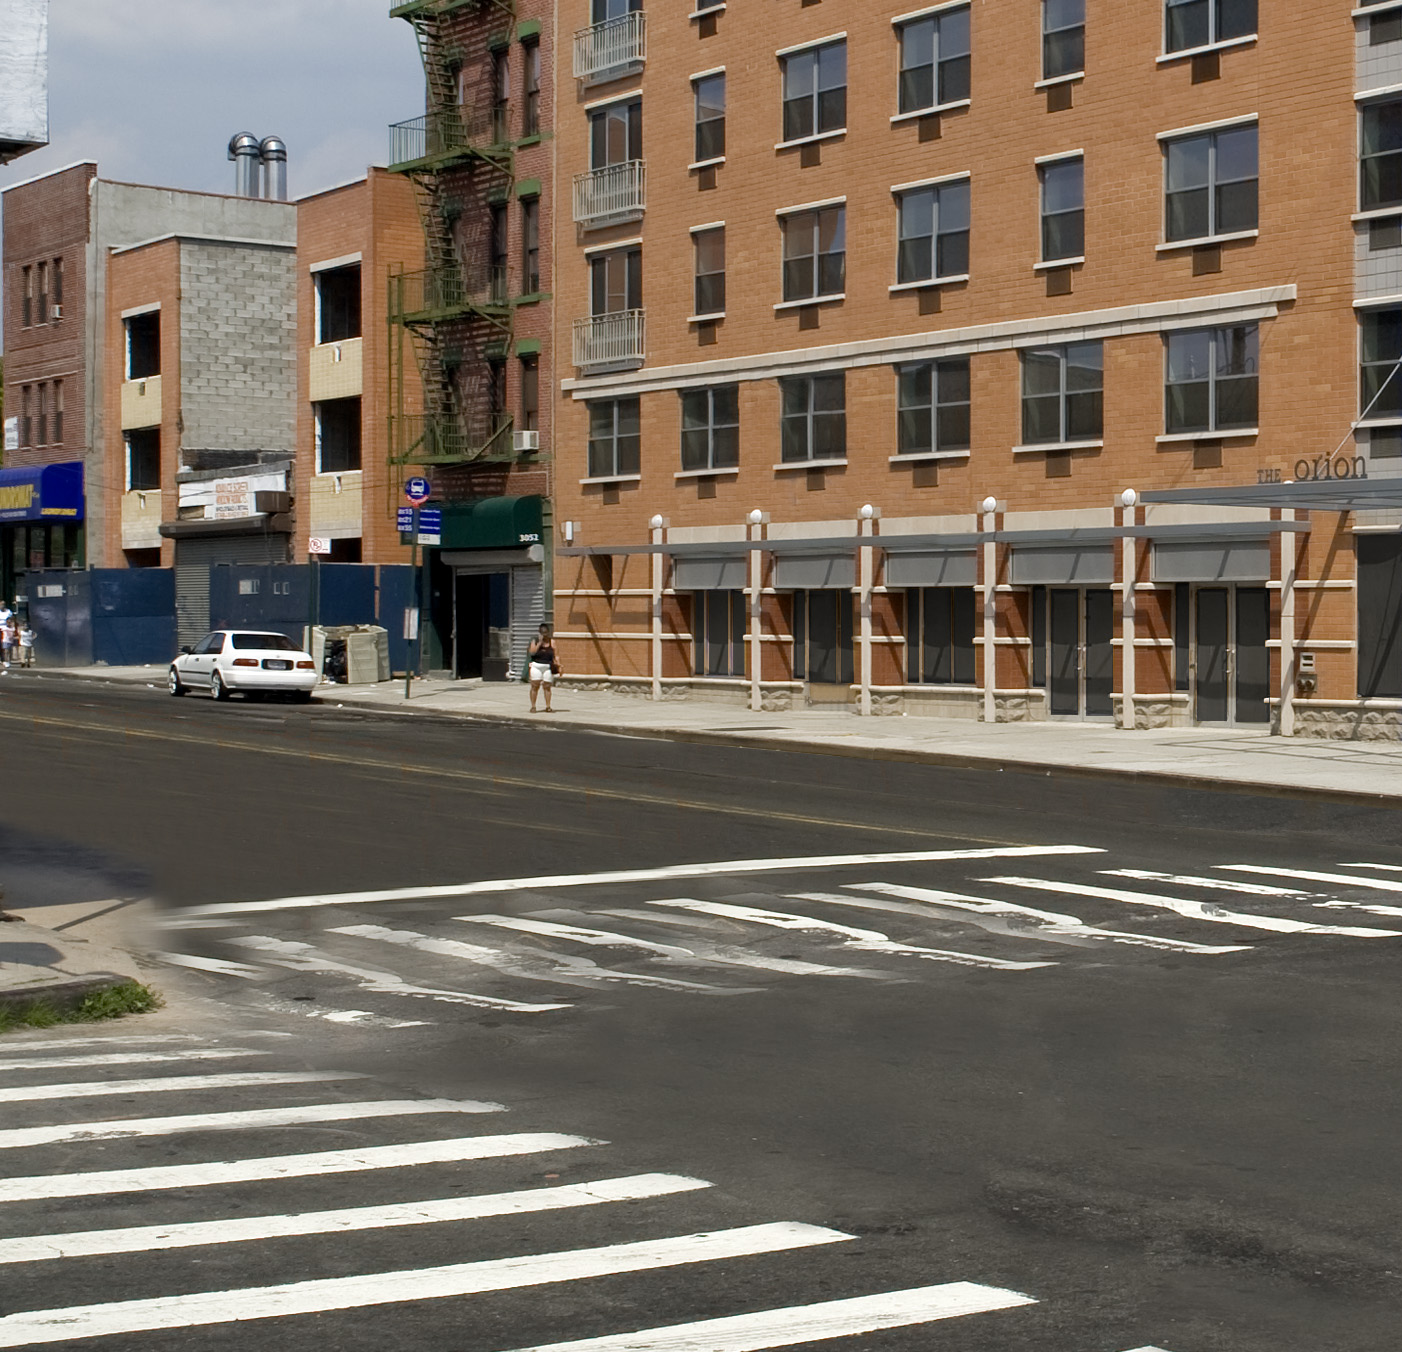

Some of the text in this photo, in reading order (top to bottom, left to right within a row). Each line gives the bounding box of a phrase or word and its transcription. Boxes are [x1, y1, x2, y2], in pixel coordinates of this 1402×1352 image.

[1257, 452, 1368, 484] THE orion
[519, 533, 540, 542] 3052
